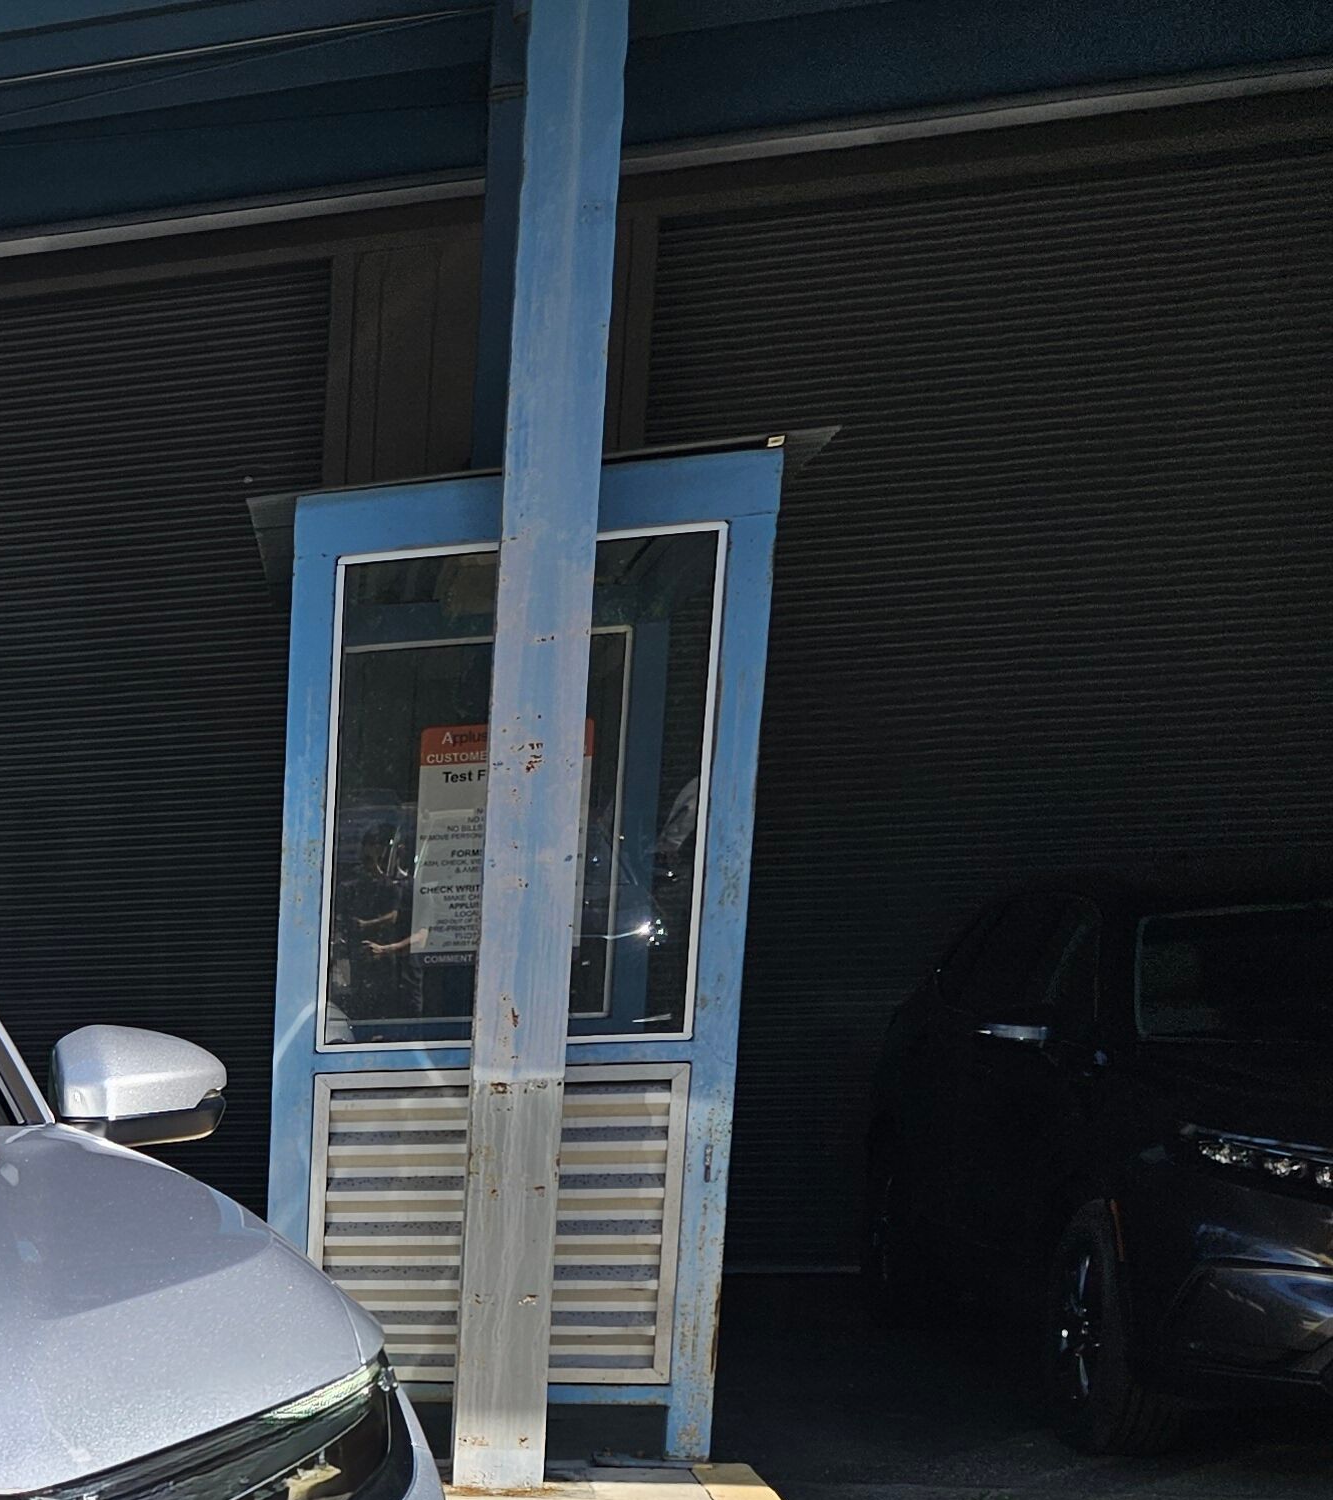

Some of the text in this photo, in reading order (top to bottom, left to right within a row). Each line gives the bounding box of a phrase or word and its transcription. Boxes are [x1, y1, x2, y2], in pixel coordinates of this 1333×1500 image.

[426, 750, 488, 764] CUSTOME
[442, 769, 486, 783] Test F
[451, 832, 483, 840] PERSON
[420, 884, 480, 895] CHECK WRIT
[423, 954, 473, 964] COMMENT
